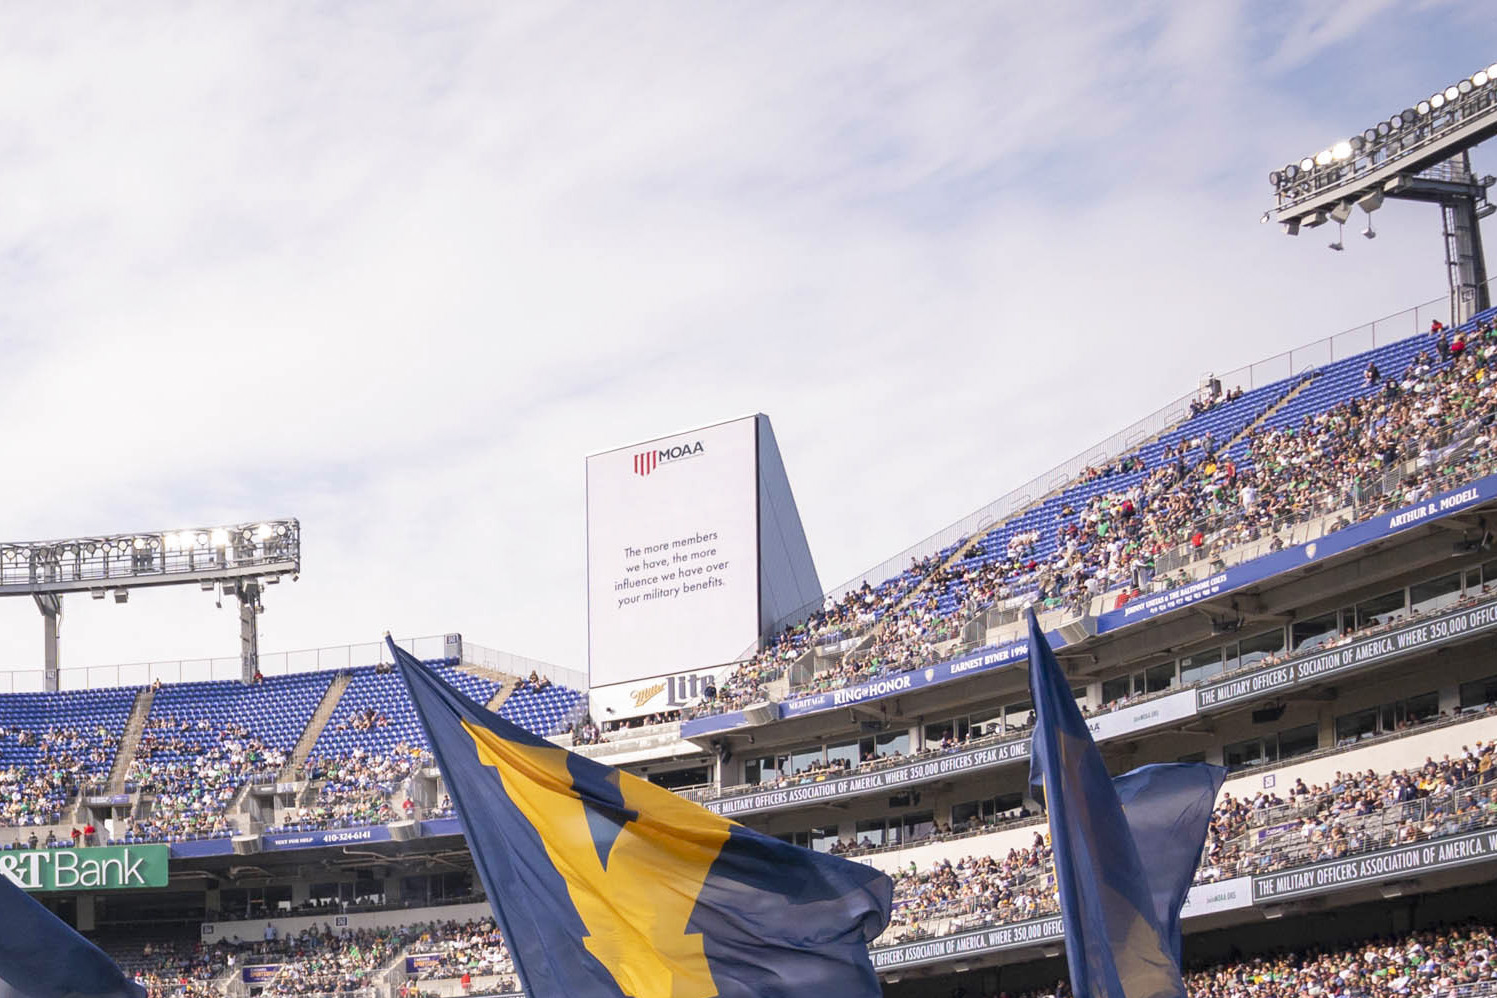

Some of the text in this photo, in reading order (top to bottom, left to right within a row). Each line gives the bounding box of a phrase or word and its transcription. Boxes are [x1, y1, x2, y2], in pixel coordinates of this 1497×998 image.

[658, 441, 704, 462] MOAA
[1389, 488, 1480, 528] ARTHUR B. MODELL
[624, 531, 718, 559] The more members
[626, 548, 717, 573] we have, the more
[614, 561, 729, 591] influence we have over
[618, 576, 725, 609] your military benefits.
[950, 658, 983, 674] EARNEST
[984, 652, 1009, 665] BYNER
[1201, 606, 1497, 705] THE MILITARY OFFICERS ASOCIATION OF AMERICA. WHERE 350,000 OFFIC
[834, 689, 862, 705] RING
[869, 675, 911, 697] HONOR
[708, 742, 1028, 814] THE MILITARY OFFICERS ASSOCIATION OF AMERICA. WHERE 350,000 OFFICERS SPEAK AS ONE.
[323, 831, 371, 843] 410-324-6141
[54, 848, 145, 888] Bank
[1257, 879, 1275, 896] THE
[1276, 871, 1315, 893] MILITARY
[1317, 861, 1358, 885] OFFICERS
[1359, 849, 1421, 877] ASSOCIATION
[1422, 847, 1436, 863] OF
[1438, 838, 1486, 861] AMERICA.
[877, 949, 904, 967] OFFICERS
[904, 941, 946, 961] ASSOCIATION
[946, 940, 955, 952] OF
[956, 933, 988, 951] AMERICA.
[989, 929, 1012, 946] WHERE
[1013, 924, 1042, 943] 350,000
[1042, 918, 1065, 936] OFFIC
